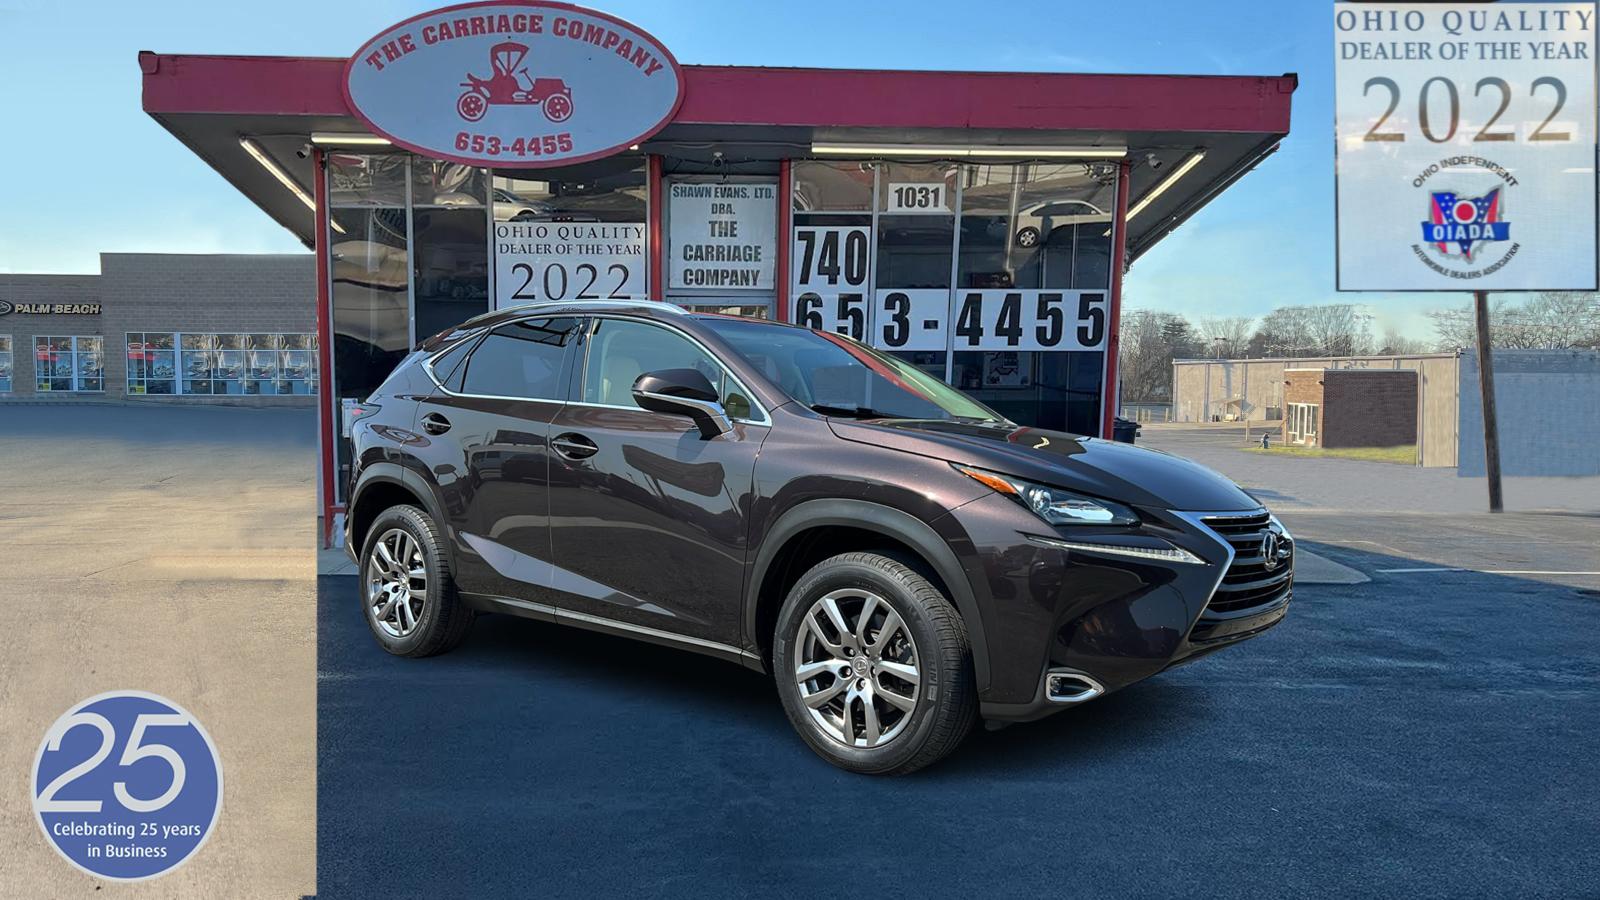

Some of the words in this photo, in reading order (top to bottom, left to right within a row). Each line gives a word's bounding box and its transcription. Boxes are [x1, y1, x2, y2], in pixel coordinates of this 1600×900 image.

[1336, 10, 1425, 32] OHIO
[1442, 10, 1593, 35] QUALITY
[366, 33, 417, 72] THE
[422, 14, 544, 45] CARRIAGE
[552, 17, 664, 77] COMPANY
[1340, 42, 1432, 60] DEALER
[1439, 42, 1469, 60] OF
[1475, 42, 1522, 60] THE
[1528, 42, 1589, 60] YEAR
[1362, 76, 1571, 143] 2022
[455, 131, 573, 156] 653-4455
[1412, 164, 1439, 188] OHIO
[1440, 155, 1519, 188] INDEPENDENT
[672, 186, 712, 199] SHAWN
[754, 186, 774, 200] LTD.
[894, 187, 941, 208] 1031
[711, 203, 736, 215] DBA.
[497, 225, 552, 238] OHIO
[558, 225, 645, 240] QUALITY
[708, 220, 738, 238] THE
[1432, 224, 1495, 240] OIADA
[499, 244, 551, 255] DEALER
[555, 243, 574, 255] OF
[576, 244, 603, 255] THE
[606, 244, 642, 255] YEAR
[683, 244, 762, 262] CARRIAGE
[797, 230, 867, 286] 740
[1411, 244, 1449, 277] AUTOMOBILE
[1449, 269, 1482, 280] DEALERS
[1482, 242, 1520, 276] ASSOCIATION
[511, 263, 631, 300] 2022
[683, 268, 760, 286] COMPANY
[14, 303, 51, 314] PALM
[54, 304, 101, 314] BEACH
